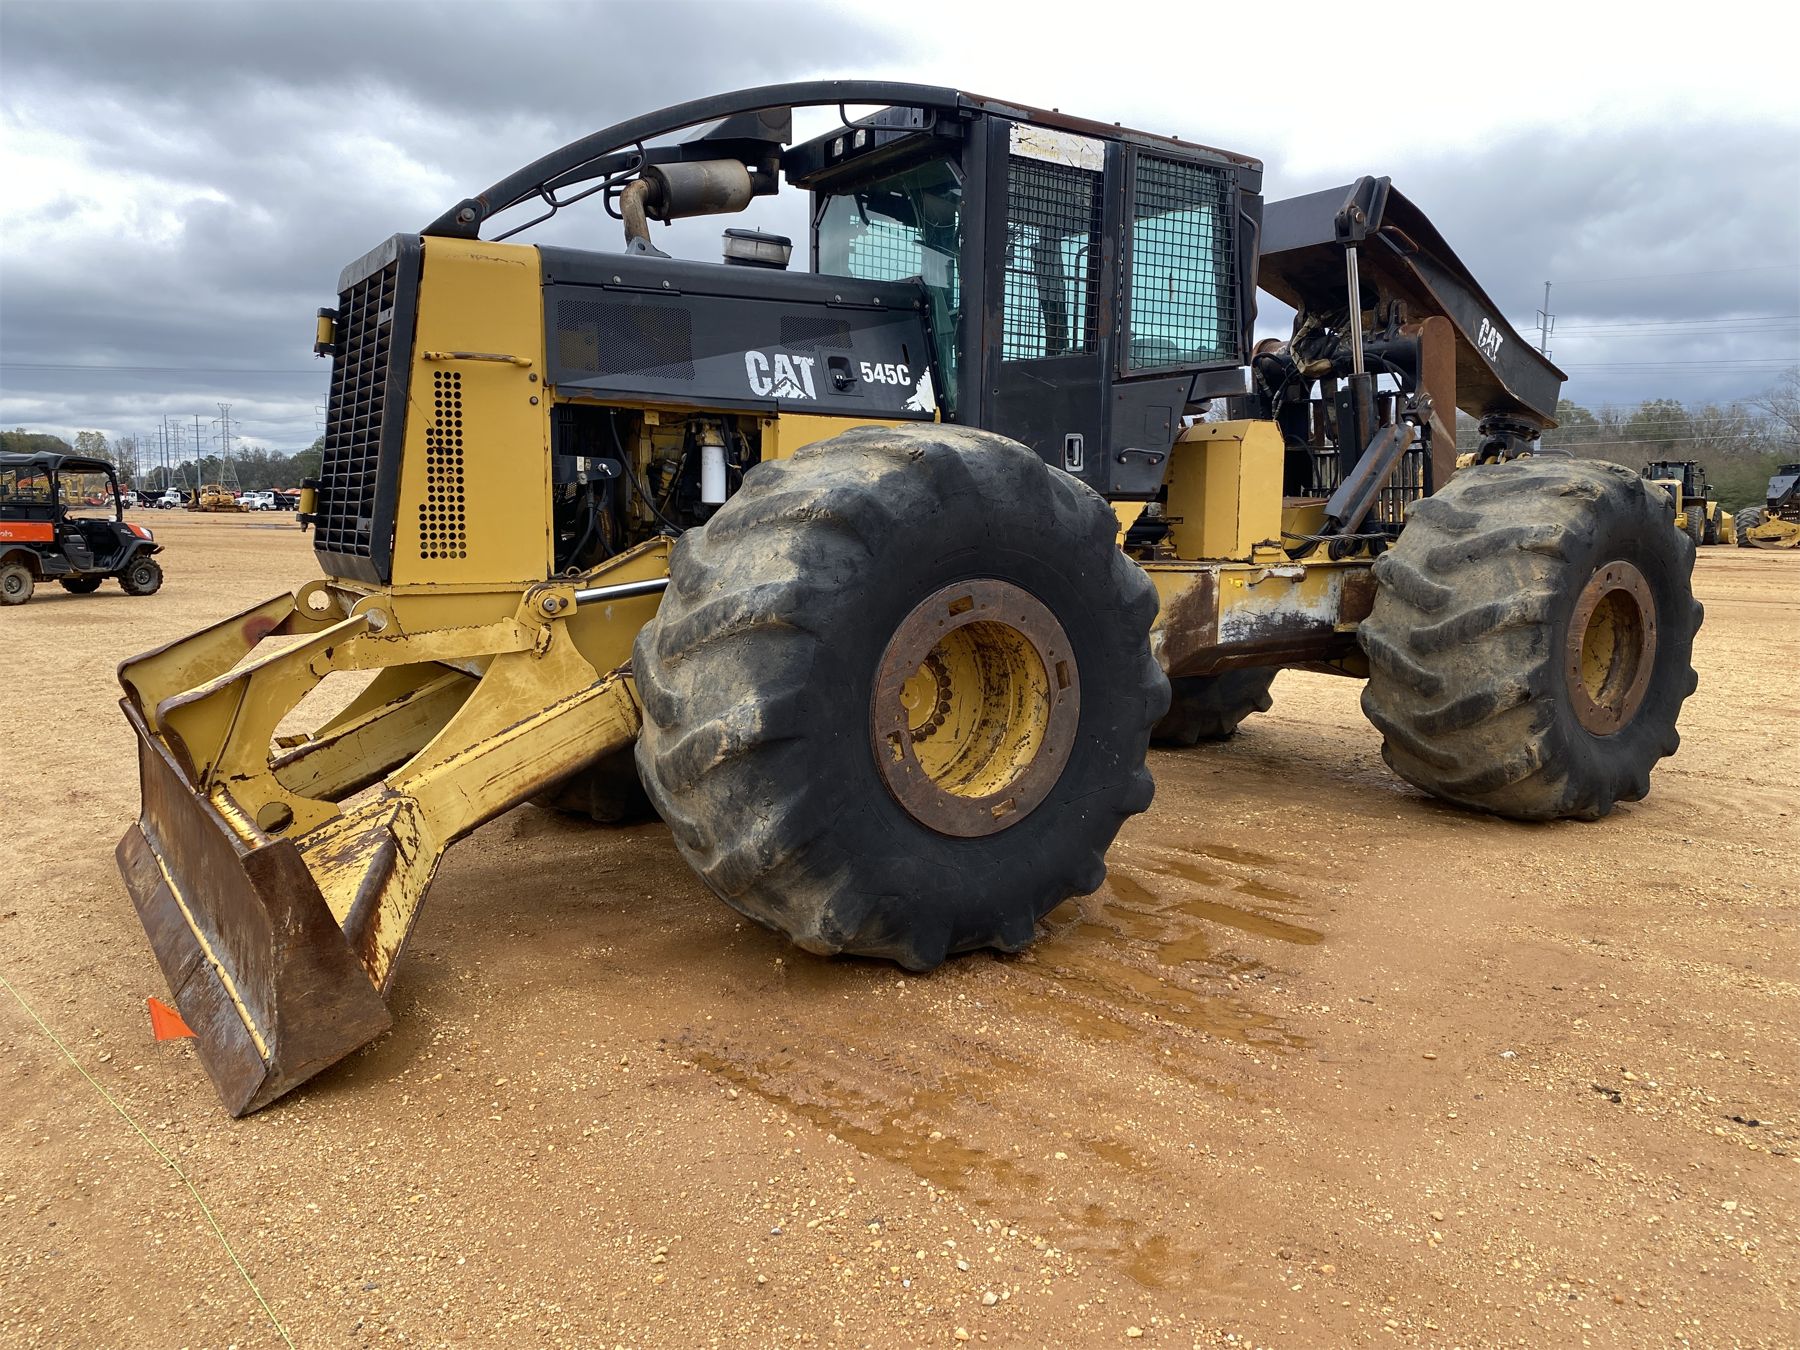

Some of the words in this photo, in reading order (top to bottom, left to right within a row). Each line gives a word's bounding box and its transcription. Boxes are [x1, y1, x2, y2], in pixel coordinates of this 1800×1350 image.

[1478, 317, 1504, 362] CAT
[744, 350, 817, 400] CAT
[859, 361, 911, 386] 545C
